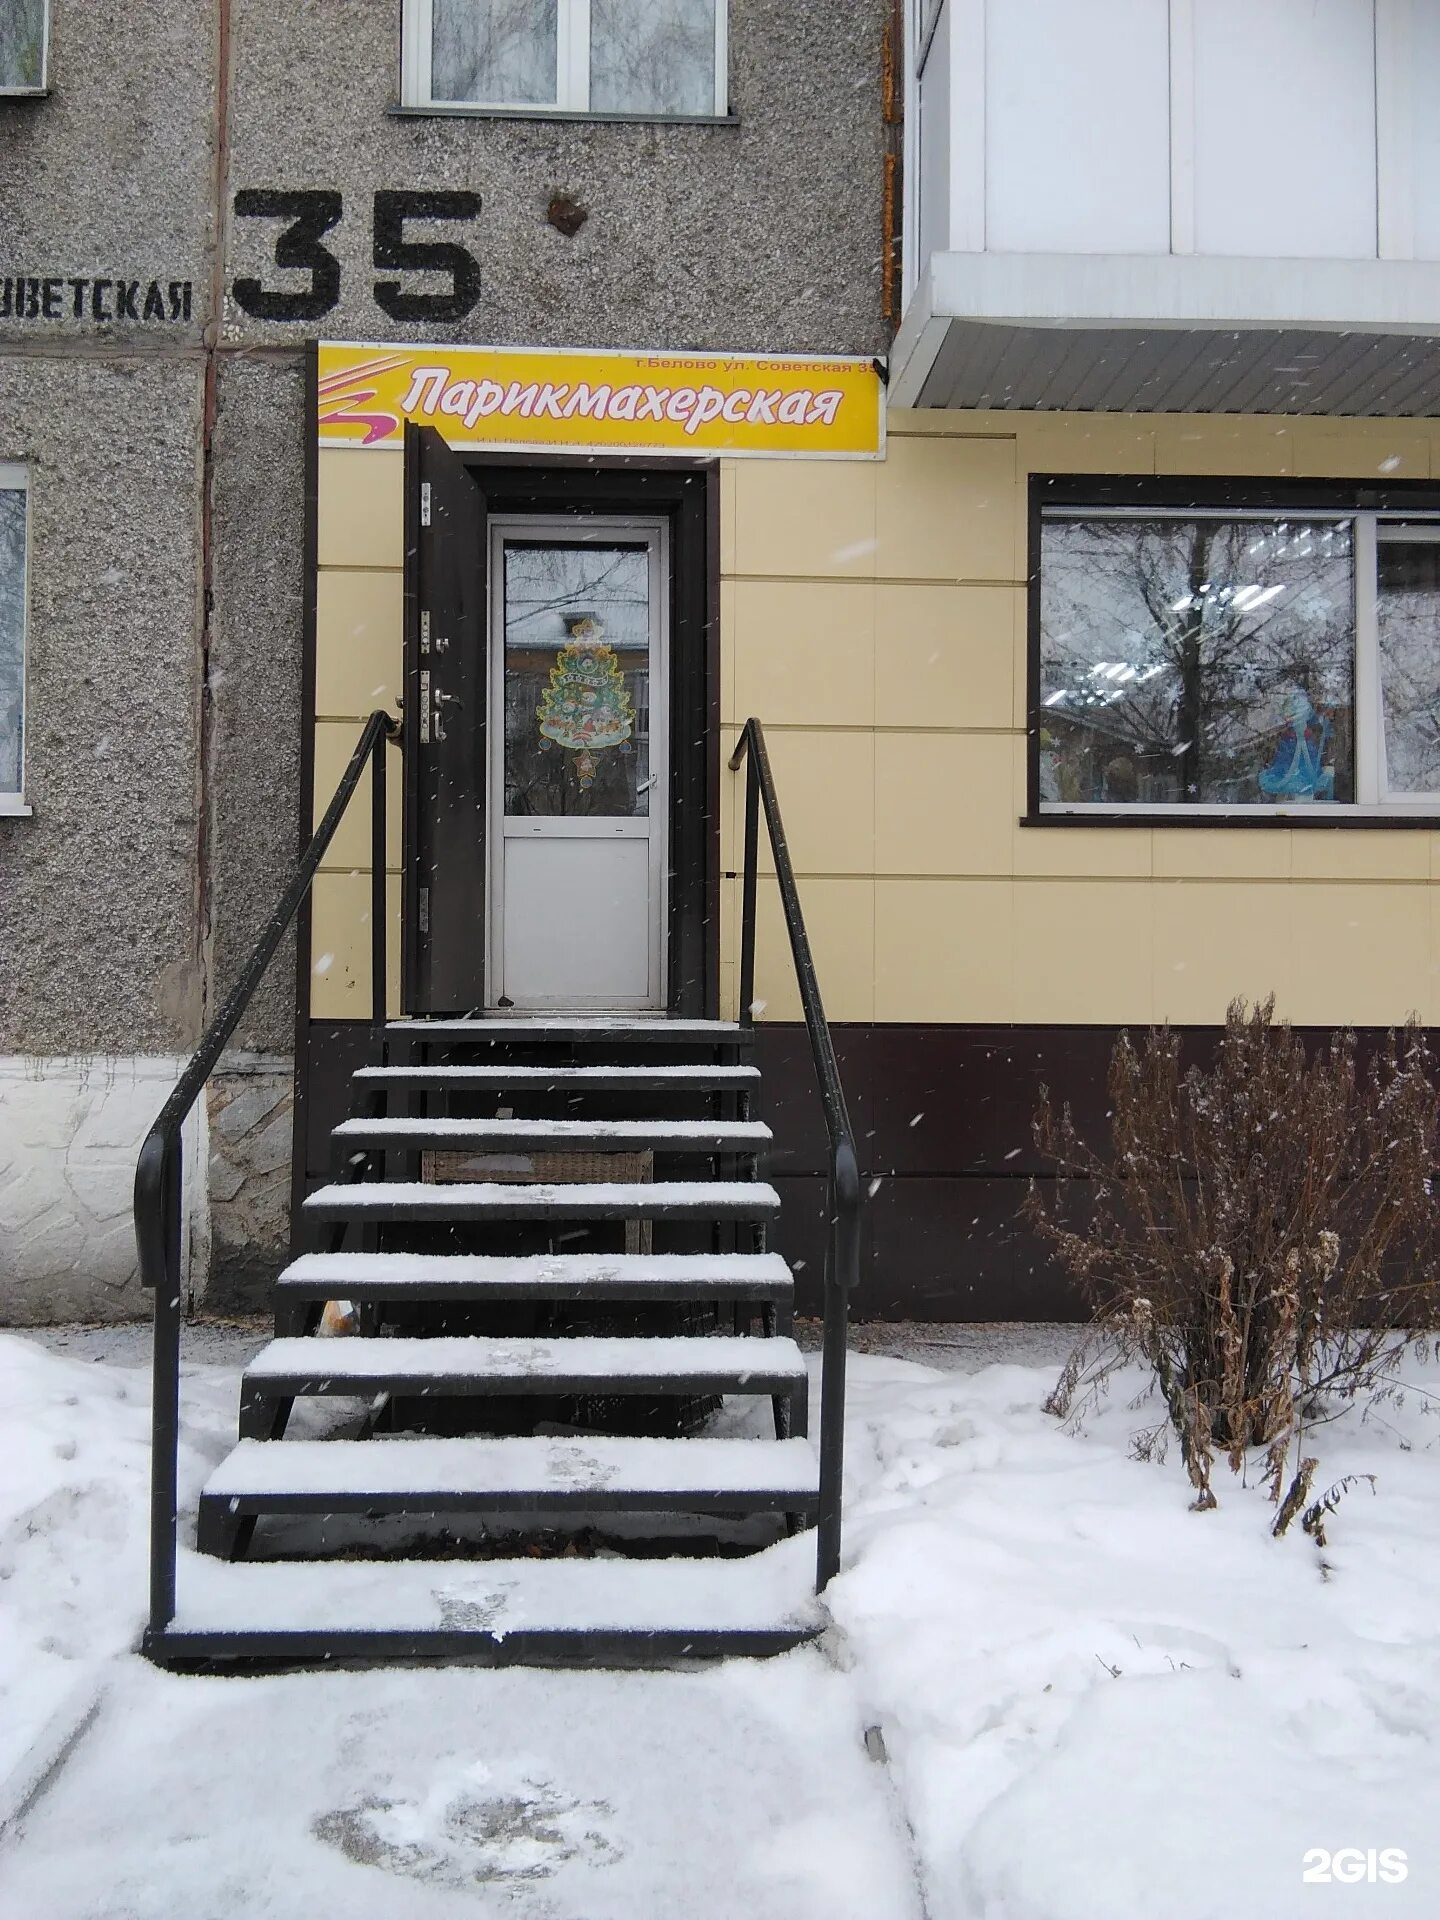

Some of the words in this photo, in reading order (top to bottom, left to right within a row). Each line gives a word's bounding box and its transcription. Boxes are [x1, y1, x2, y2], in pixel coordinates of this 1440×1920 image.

[233, 189, 482, 322] 35
[401, 366, 845, 435] Парикмахерская
[723, 361, 750, 373] ул.
[756, 360, 852, 374] Советская
